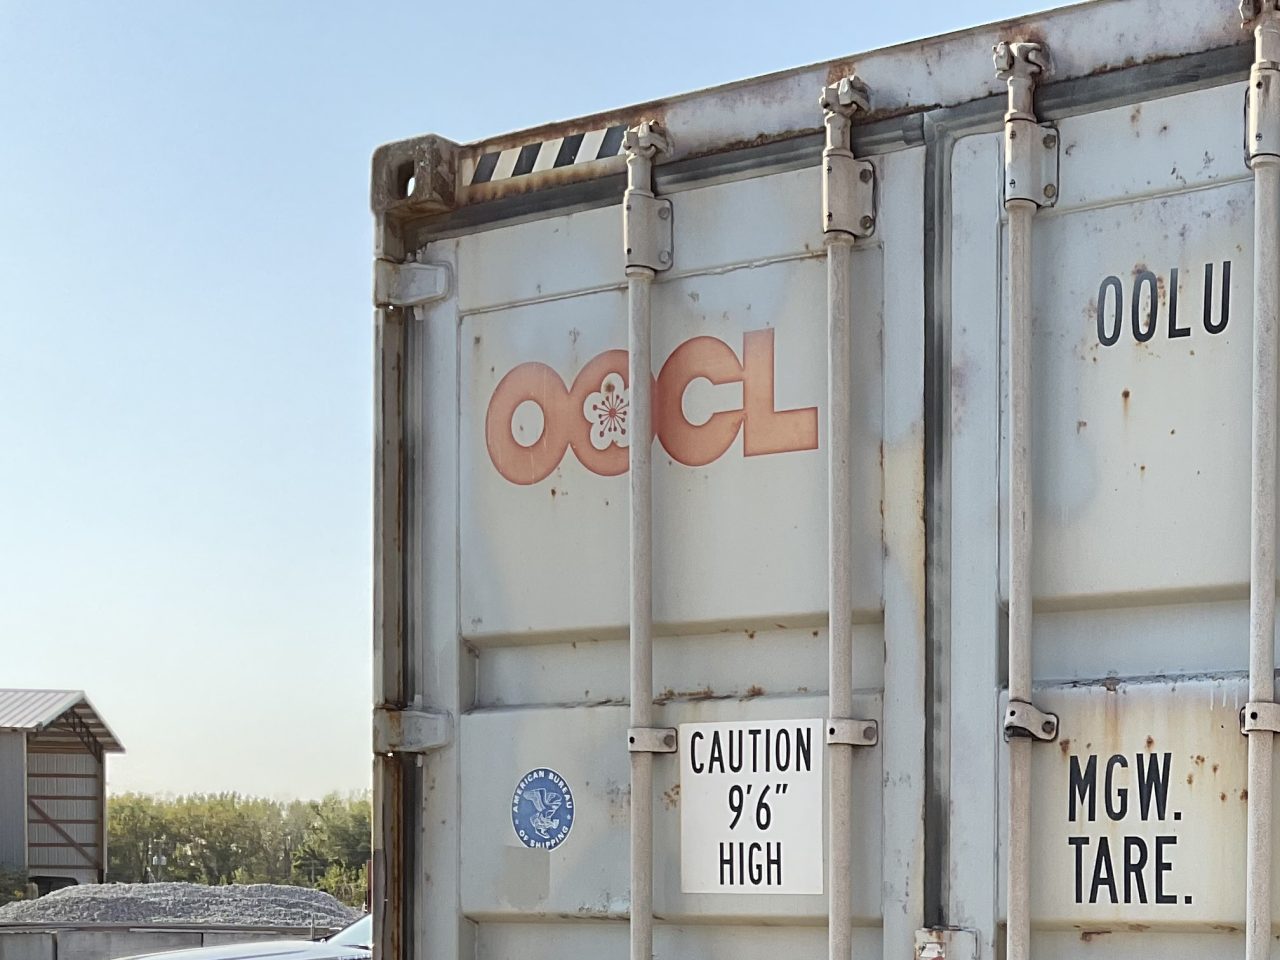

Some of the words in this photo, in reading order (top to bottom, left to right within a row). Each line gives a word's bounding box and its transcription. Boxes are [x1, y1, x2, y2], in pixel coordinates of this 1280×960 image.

[1097, 260, 1232, 346] OOLU
[486, 327, 818, 485] OOCL
[690, 727, 811, 773] CAUTION
[513, 770, 545, 812] AMERICAN
[548, 772, 572, 809] BUREAU
[1068, 752, 1182, 822] MGW.
[519, 829, 530, 842] OF
[529, 825, 569, 849] SHIPPING
[719, 842, 782, 886] HIGH
[1068, 835, 1193, 905] TARE.
